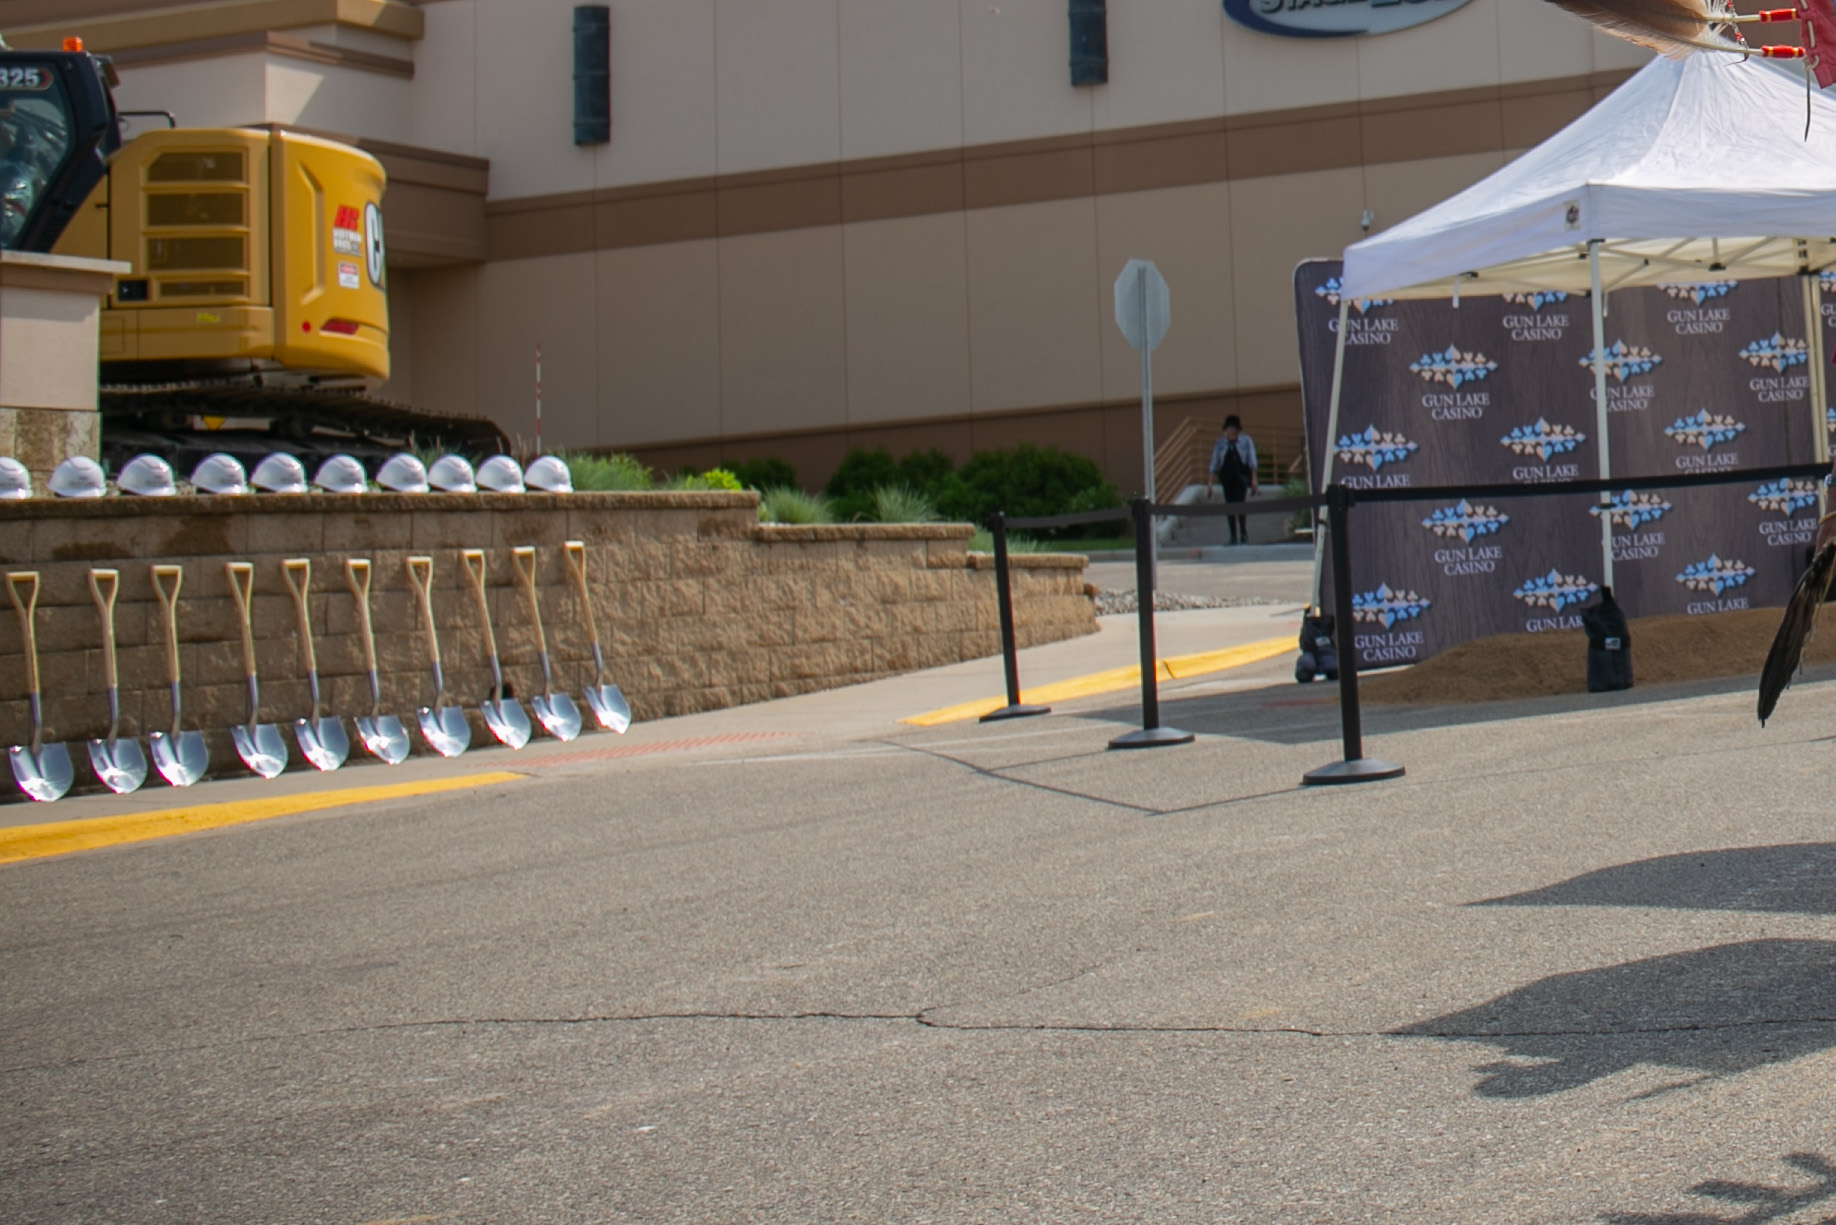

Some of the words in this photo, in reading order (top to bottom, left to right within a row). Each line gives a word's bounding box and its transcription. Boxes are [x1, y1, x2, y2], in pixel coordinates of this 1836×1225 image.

[1503, 315, 1536, 329] GUN
[1536, 314, 1569, 327] LAKE
[1667, 309, 1699, 322] GUN
[1699, 308, 1730, 321] LAKE
[1364, 317, 1399, 332] LAKE
[1675, 322, 1723, 335] CASINO
[1511, 329, 1562, 341] CASINO
[1750, 378, 1780, 391] GUN
[1779, 376, 1809, 389] LAKE
[1622, 385, 1654, 399] LAKE
[1758, 389, 1803, 402] CASINO
[1422, 394, 1455, 408] GUN
[1454, 393, 1490, 406] LAKE
[1431, 407, 1483, 420] CASINO
[1675, 455, 1707, 469] GUN
[1706, 453, 1738, 466] LAKE
[1512, 466, 1546, 480] GUN
[1545, 465, 1578, 478] LAKE
[1341, 476, 1377, 489] GUN
[1376, 475, 1410, 487] LAKE
[1759, 521, 1788, 535] GUN
[1788, 518, 1817, 531] LAKE
[1633, 533, 1665, 545] LAKE
[1767, 532, 1812, 546] CASINO
[1434, 549, 1468, 563] GUN
[1468, 546, 1502, 560] LAKE
[1444, 561, 1495, 575] CASINO
[1687, 601, 1717, 614] GUN
[1717, 598, 1748, 612] LAKE
[1526, 618, 1559, 632] GUN
[1559, 616, 1584, 630] LAK
[1354, 634, 1388, 648] GUN
[1388, 631, 1423, 645] LAKE
[1363, 647, 1416, 661] CASINO
